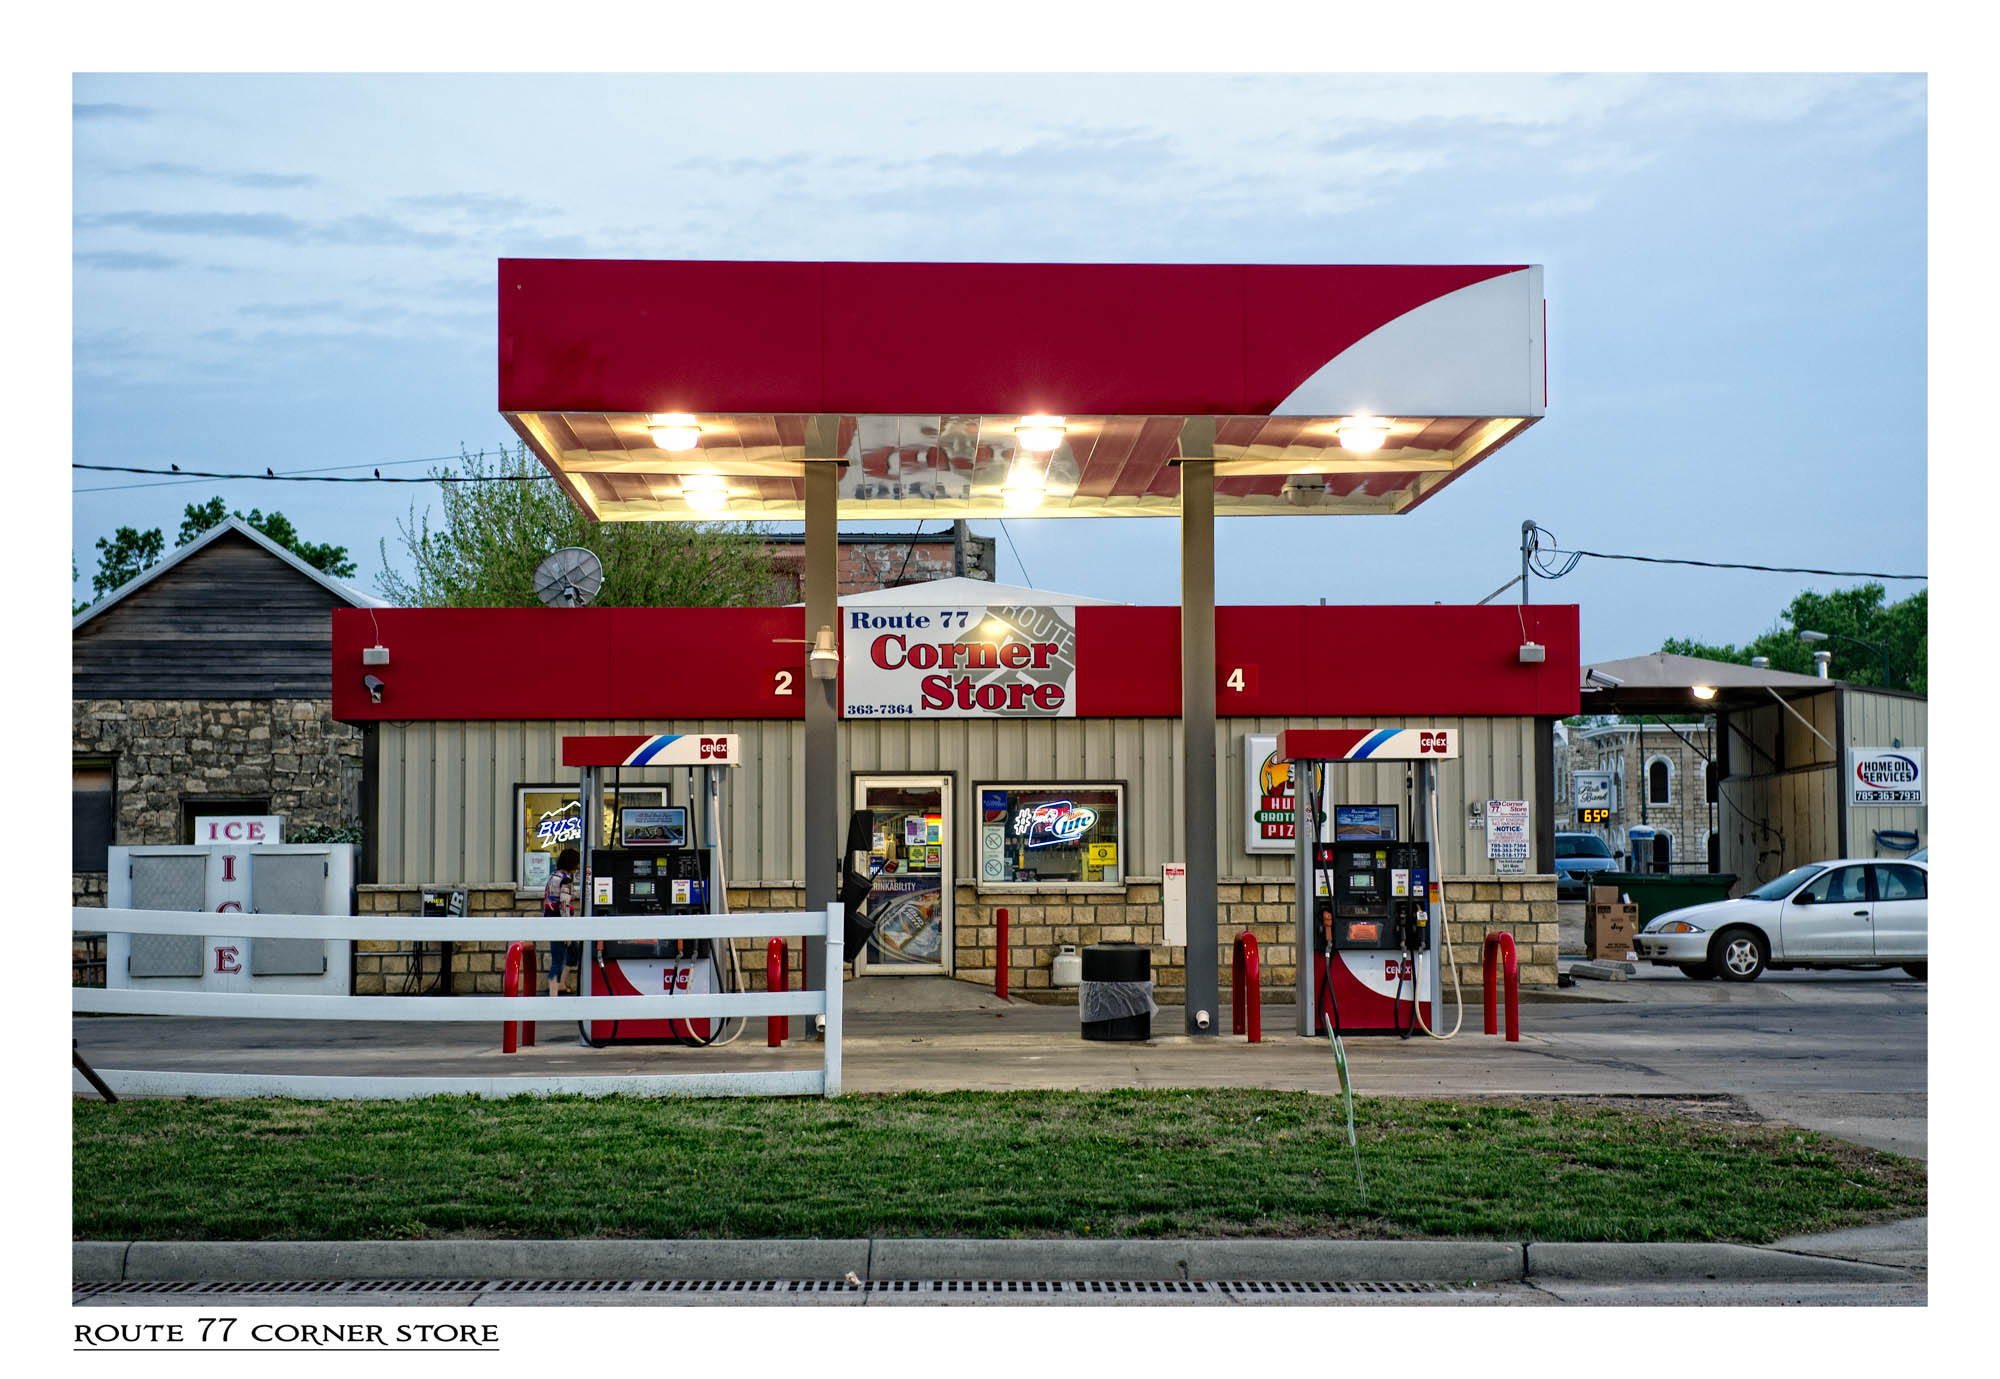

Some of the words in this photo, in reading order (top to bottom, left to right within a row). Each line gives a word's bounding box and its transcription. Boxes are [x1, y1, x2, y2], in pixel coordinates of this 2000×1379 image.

[850, 611, 931, 629] Route
[940, 611, 969, 629] 77
[870, 633, 1060, 670] Corner
[774, 670, 793, 695] 2
[1226, 668, 1246, 692] 4
[920, 674, 1066, 711] Store
[847, 704, 914, 716] 363-7364
[701, 744, 727, 752] CENEX
[1421, 738, 1447, 747] CENEX
[1864, 761, 1893, 772] HOME
[1894, 761, 1911, 772] OIL
[1863, 772, 1912, 783] SERVICES
[1856, 791, 1920, 801] 785-363-7931
[1271, 797, 1296, 810] HU
[208, 821, 266, 841] ICE
[1060, 815, 1091, 836] Lite
[1268, 824, 1294, 837] PIZ
[541, 828, 582, 849] LIGH
[873, 882, 916, 891] RINKABILITY
[1385, 966, 1412, 974] CENX
